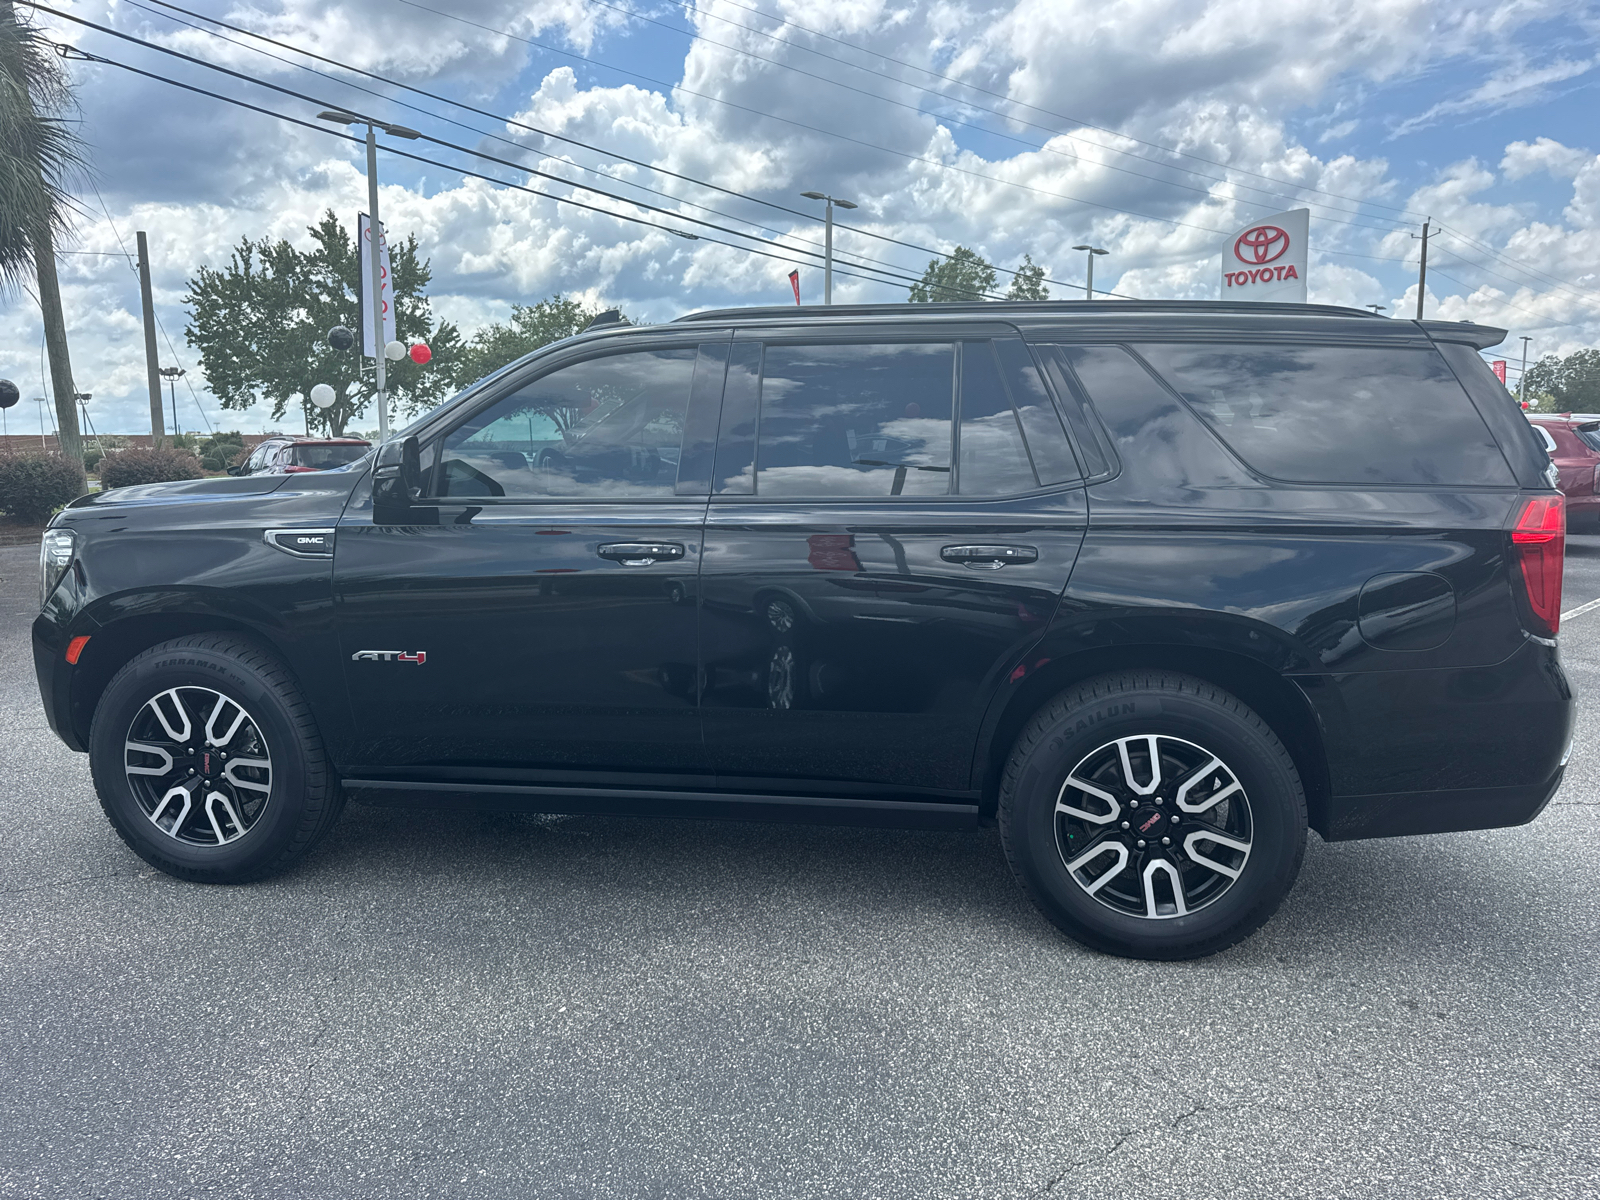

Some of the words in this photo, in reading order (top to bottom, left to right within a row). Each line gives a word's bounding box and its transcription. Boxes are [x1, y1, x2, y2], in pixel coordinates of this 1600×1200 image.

[1225, 265, 1298, 287] TOYOTA
[154, 658, 228, 675] TERRAMAX
[352, 650, 427, 666] AT4
[1063, 702, 1136, 739] SAILUN
[1139, 813, 1161, 832] GMC
